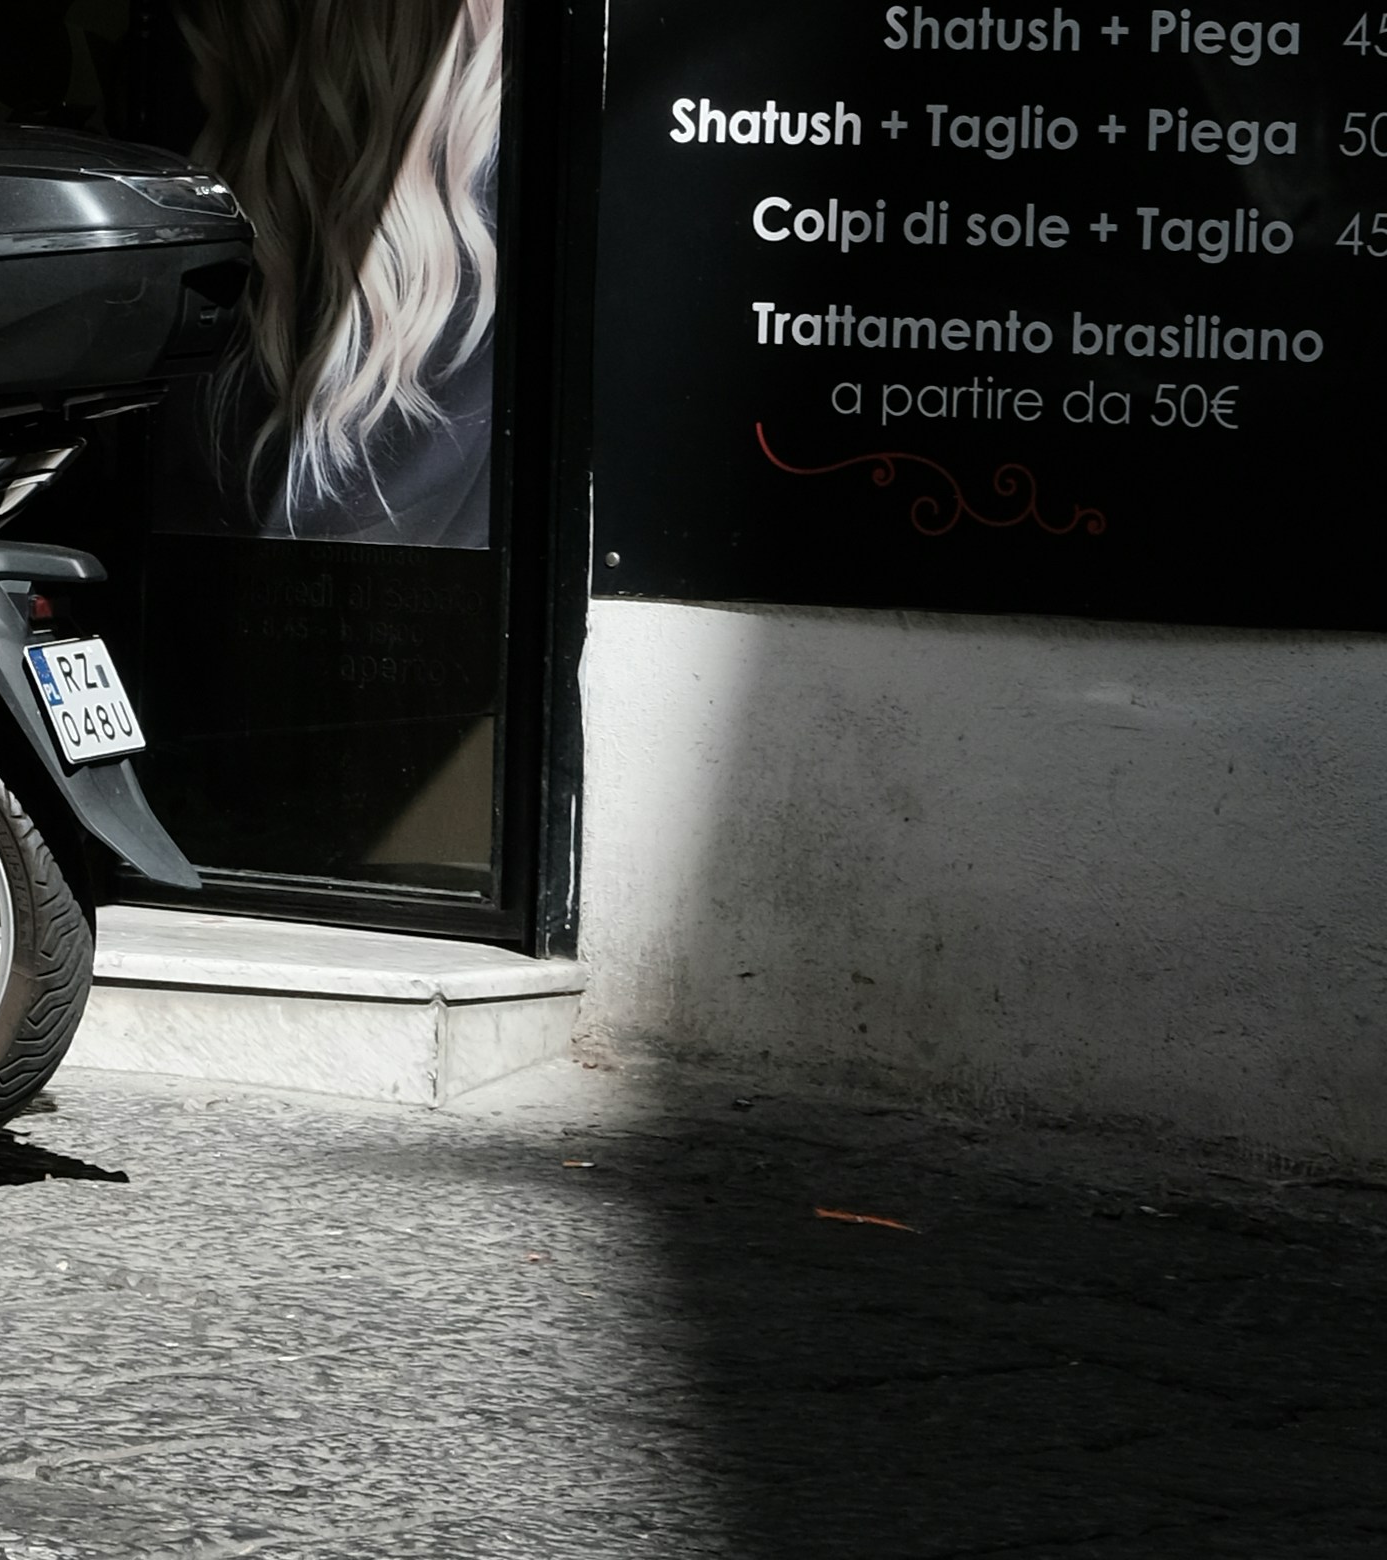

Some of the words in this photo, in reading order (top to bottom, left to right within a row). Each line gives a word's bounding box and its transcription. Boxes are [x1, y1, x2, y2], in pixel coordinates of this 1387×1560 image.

[883, 5, 1081, 52] Shatush
[1100, 15, 1130, 46] +
[1150, 8, 1300, 67] Piega
[668, 97, 862, 146] Shatush
[880, 110, 909, 140] +
[925, 104, 1079, 160] Taglio
[1098, 114, 1127, 144] +
[1147, 107, 1297, 166] Piega
[752, 195, 887, 254] Colpi
[903, 200, 950, 245] di
[965, 203, 1070, 249] sole
[1089, 212, 1118, 243] +
[1136, 207, 1294, 264] Taglio
[1334, 211, 1387, 257] 45
[751, 301, 1053, 354] Trattamento
[1072, 311, 1325, 363] brasiliano
[831, 382, 862, 415] a
[881, 375, 1044, 426] partire
[1062, 380, 1131, 425] da
[1150, 383, 1240, 430] 50€
[43, 682, 61, 703] PL
[55, 652, 99, 693] RZ
[60, 700, 134, 748] 048U
